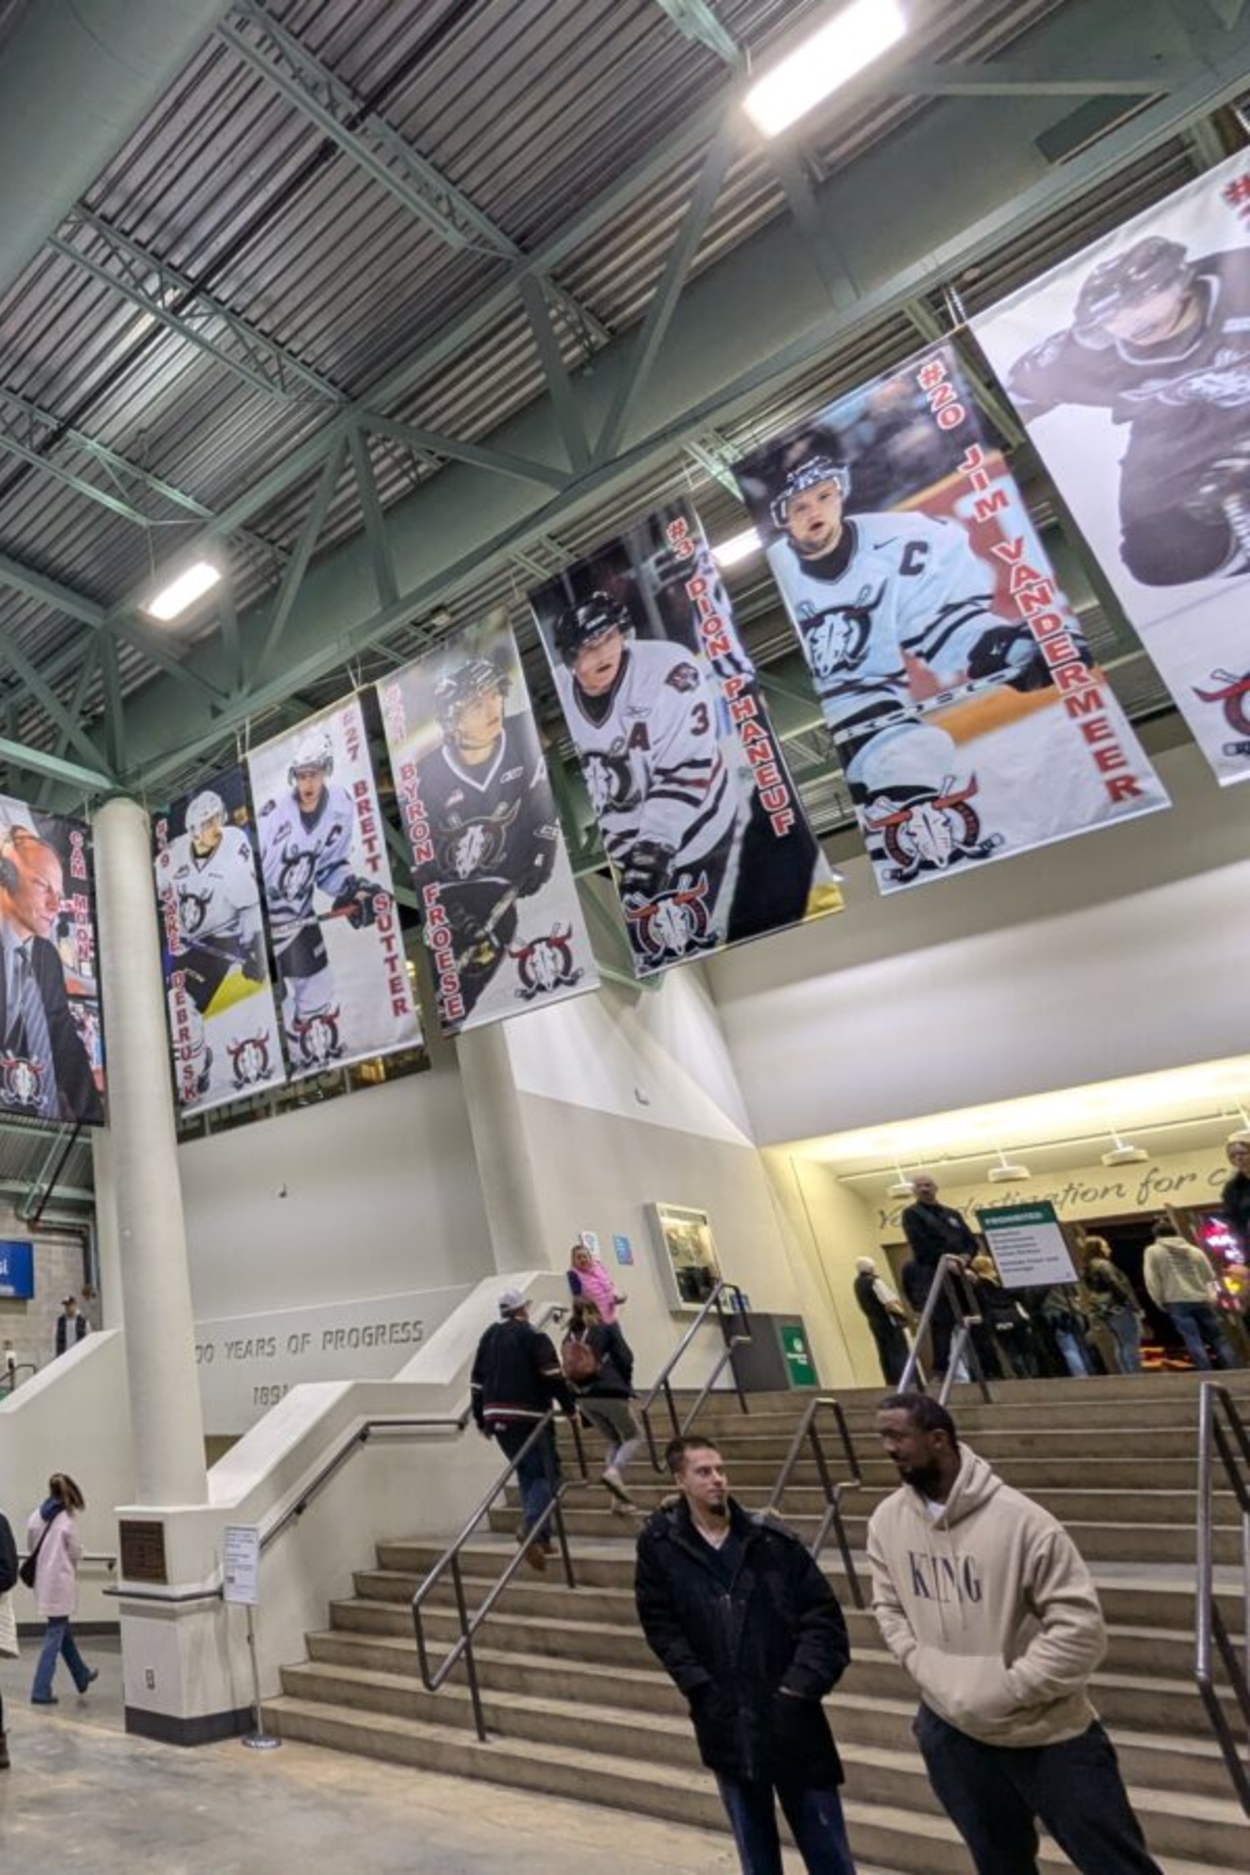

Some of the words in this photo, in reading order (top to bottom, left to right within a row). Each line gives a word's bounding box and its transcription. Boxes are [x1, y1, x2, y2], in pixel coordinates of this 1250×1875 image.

[899, 540, 929, 577] C
[918, 361, 966, 430] #20
[958, 445, 1009, 521] JIM
[991, 536, 1144, 804] VANDERMEER
[667, 517, 694, 560] #3
[687, 577, 731, 659] DION
[724, 677, 795, 836] PHANEUF
[627, 722, 650, 751] A
[690, 702, 709, 736] 3
[69, 831, 86, 879] CAM
[354, 780, 381, 872] BRETT
[372, 893, 410, 1017] SUTTER
[400, 763, 434, 864] BYRON
[422, 883, 464, 1018] FROESE
[74, 894, 90, 961] MOON
[172, 970, 198, 1102] DEBRUSK
[1137, 1166, 1198, 1211] for
[224, 1336, 277, 1360] YEARS
[287, 1332, 311, 1354] OF
[321, 1320, 425, 1351] PROGRESS
[908, 1550, 983, 1604] KING
